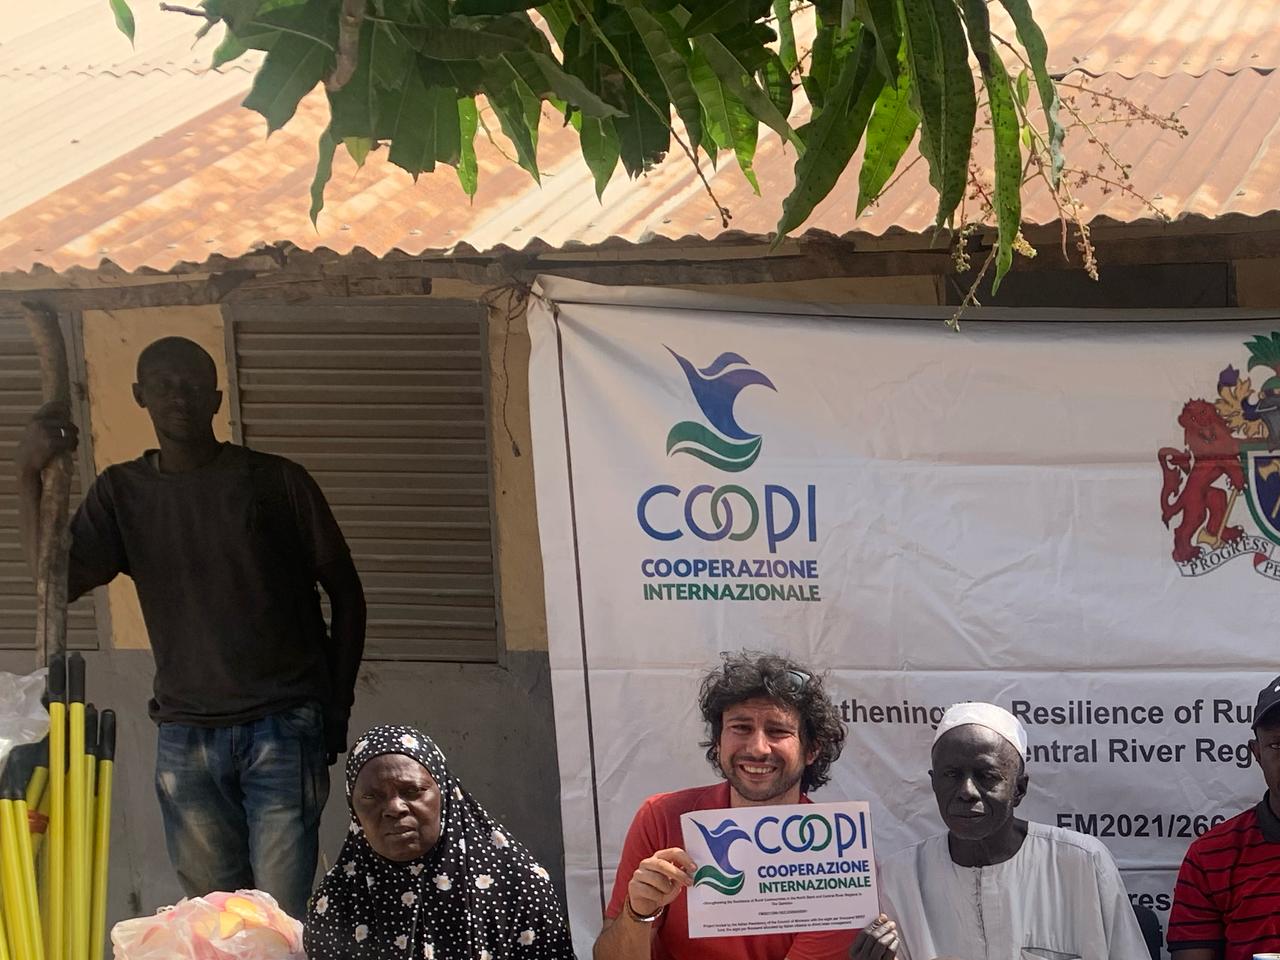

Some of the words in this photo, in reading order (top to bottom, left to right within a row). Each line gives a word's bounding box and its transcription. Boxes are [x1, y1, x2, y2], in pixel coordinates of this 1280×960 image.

[637, 484, 817, 553] COOPI
[641, 558, 819, 579] COOPERAZIONE
[1189, 535, 1271, 577] PROGRESS
[643, 582, 821, 602] INTERNAZIONALE
[835, 699, 945, 730] thening
[1011, 699, 1164, 725] Resilience
[1174, 699, 1204, 724] of
[1213, 699, 1253, 724] Ru
[1109, 738, 1186, 763] River
[1196, 738, 1252, 768] Reg
[754, 811, 867, 857] COOPI
[757, 860, 870, 879] COOPERAZIONE
[759, 876, 871, 894] INTERNAZIONALE
